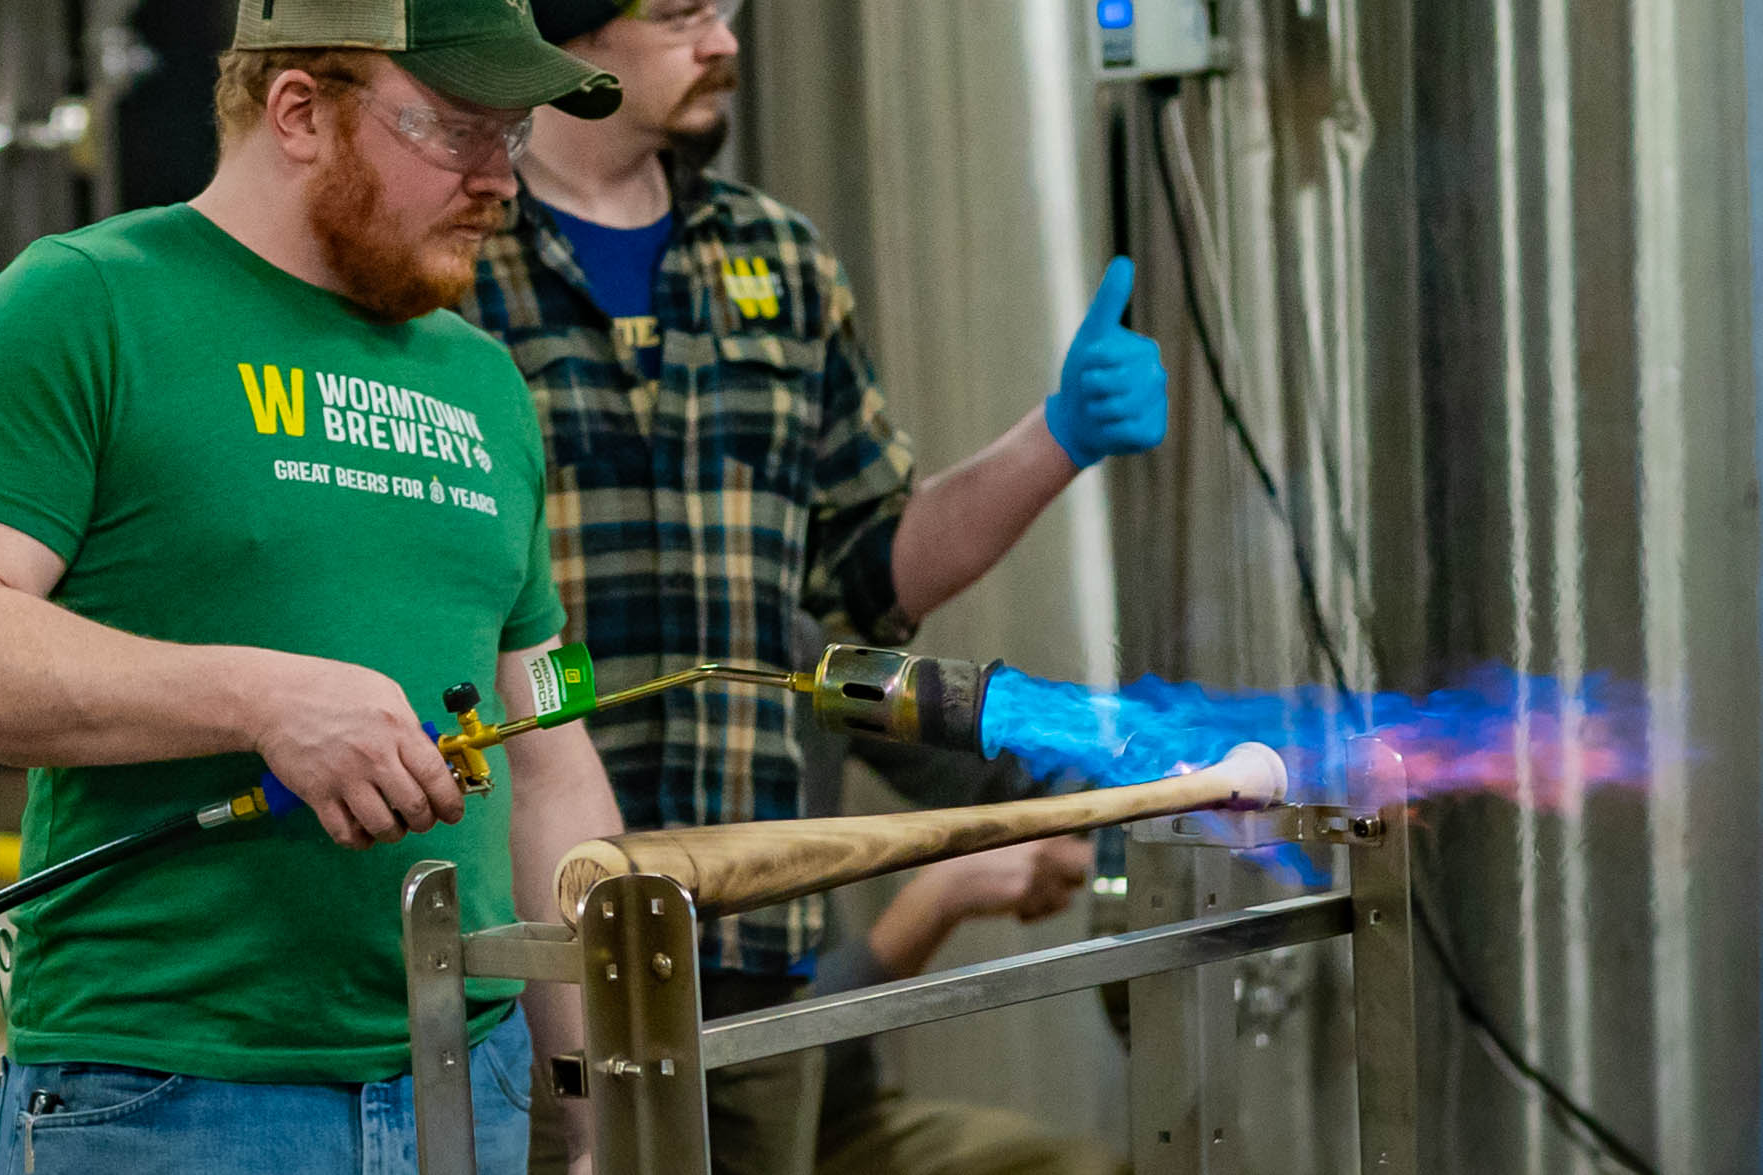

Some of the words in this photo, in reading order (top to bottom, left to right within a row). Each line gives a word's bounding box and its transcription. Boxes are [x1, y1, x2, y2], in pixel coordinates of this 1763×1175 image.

[238, 363, 305, 437] W
[316, 371, 484, 441] WORMTOWN
[323, 406, 472, 468] BREWERY
[274, 459, 331, 485] GREAT
[335, 467, 389, 494] BEERS
[391, 476, 424, 500] FOR
[448, 485, 498, 517] YEARS
[530, 659, 548, 712] TORCH
[539, 657, 556, 710] PROPANE
